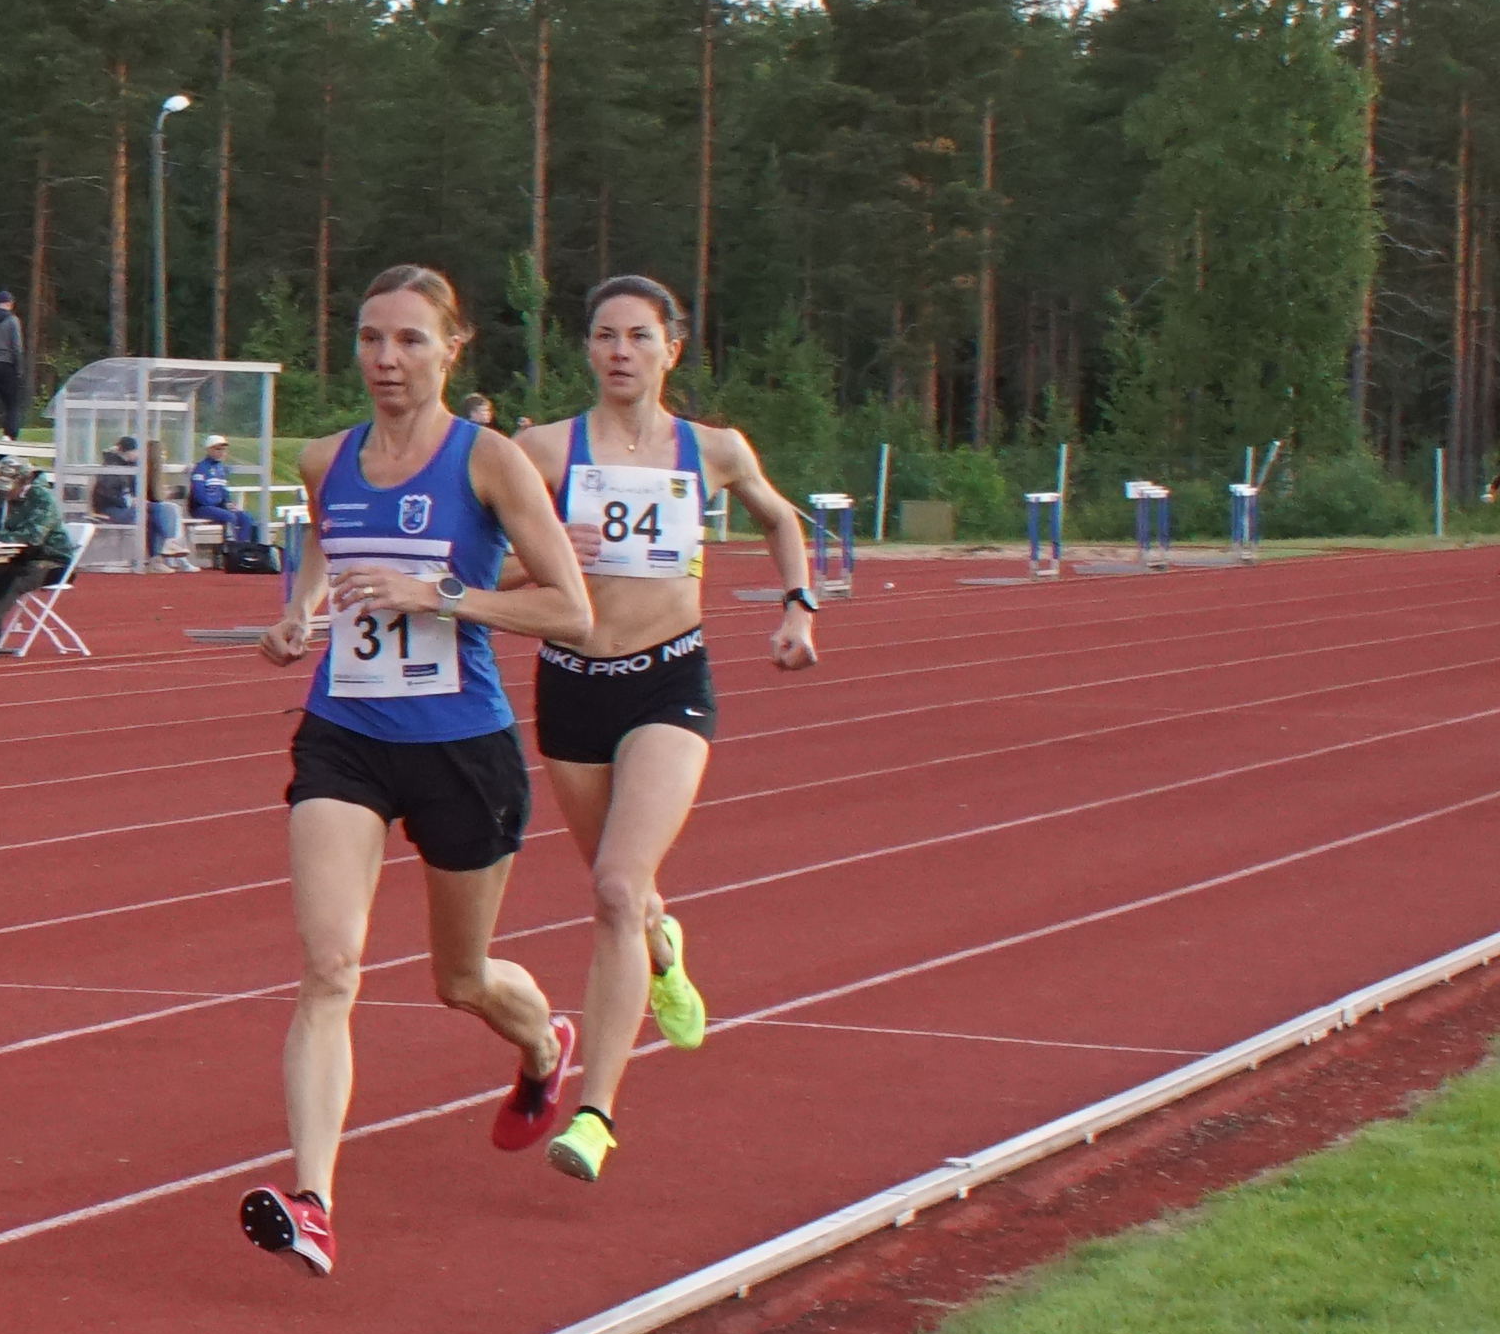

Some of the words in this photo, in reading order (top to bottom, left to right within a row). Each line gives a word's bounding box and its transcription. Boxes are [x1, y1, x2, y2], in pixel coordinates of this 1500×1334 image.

[602, 500, 663, 544] 84
[353, 613, 409, 660] 31
[588, 654, 652, 676] PRO
